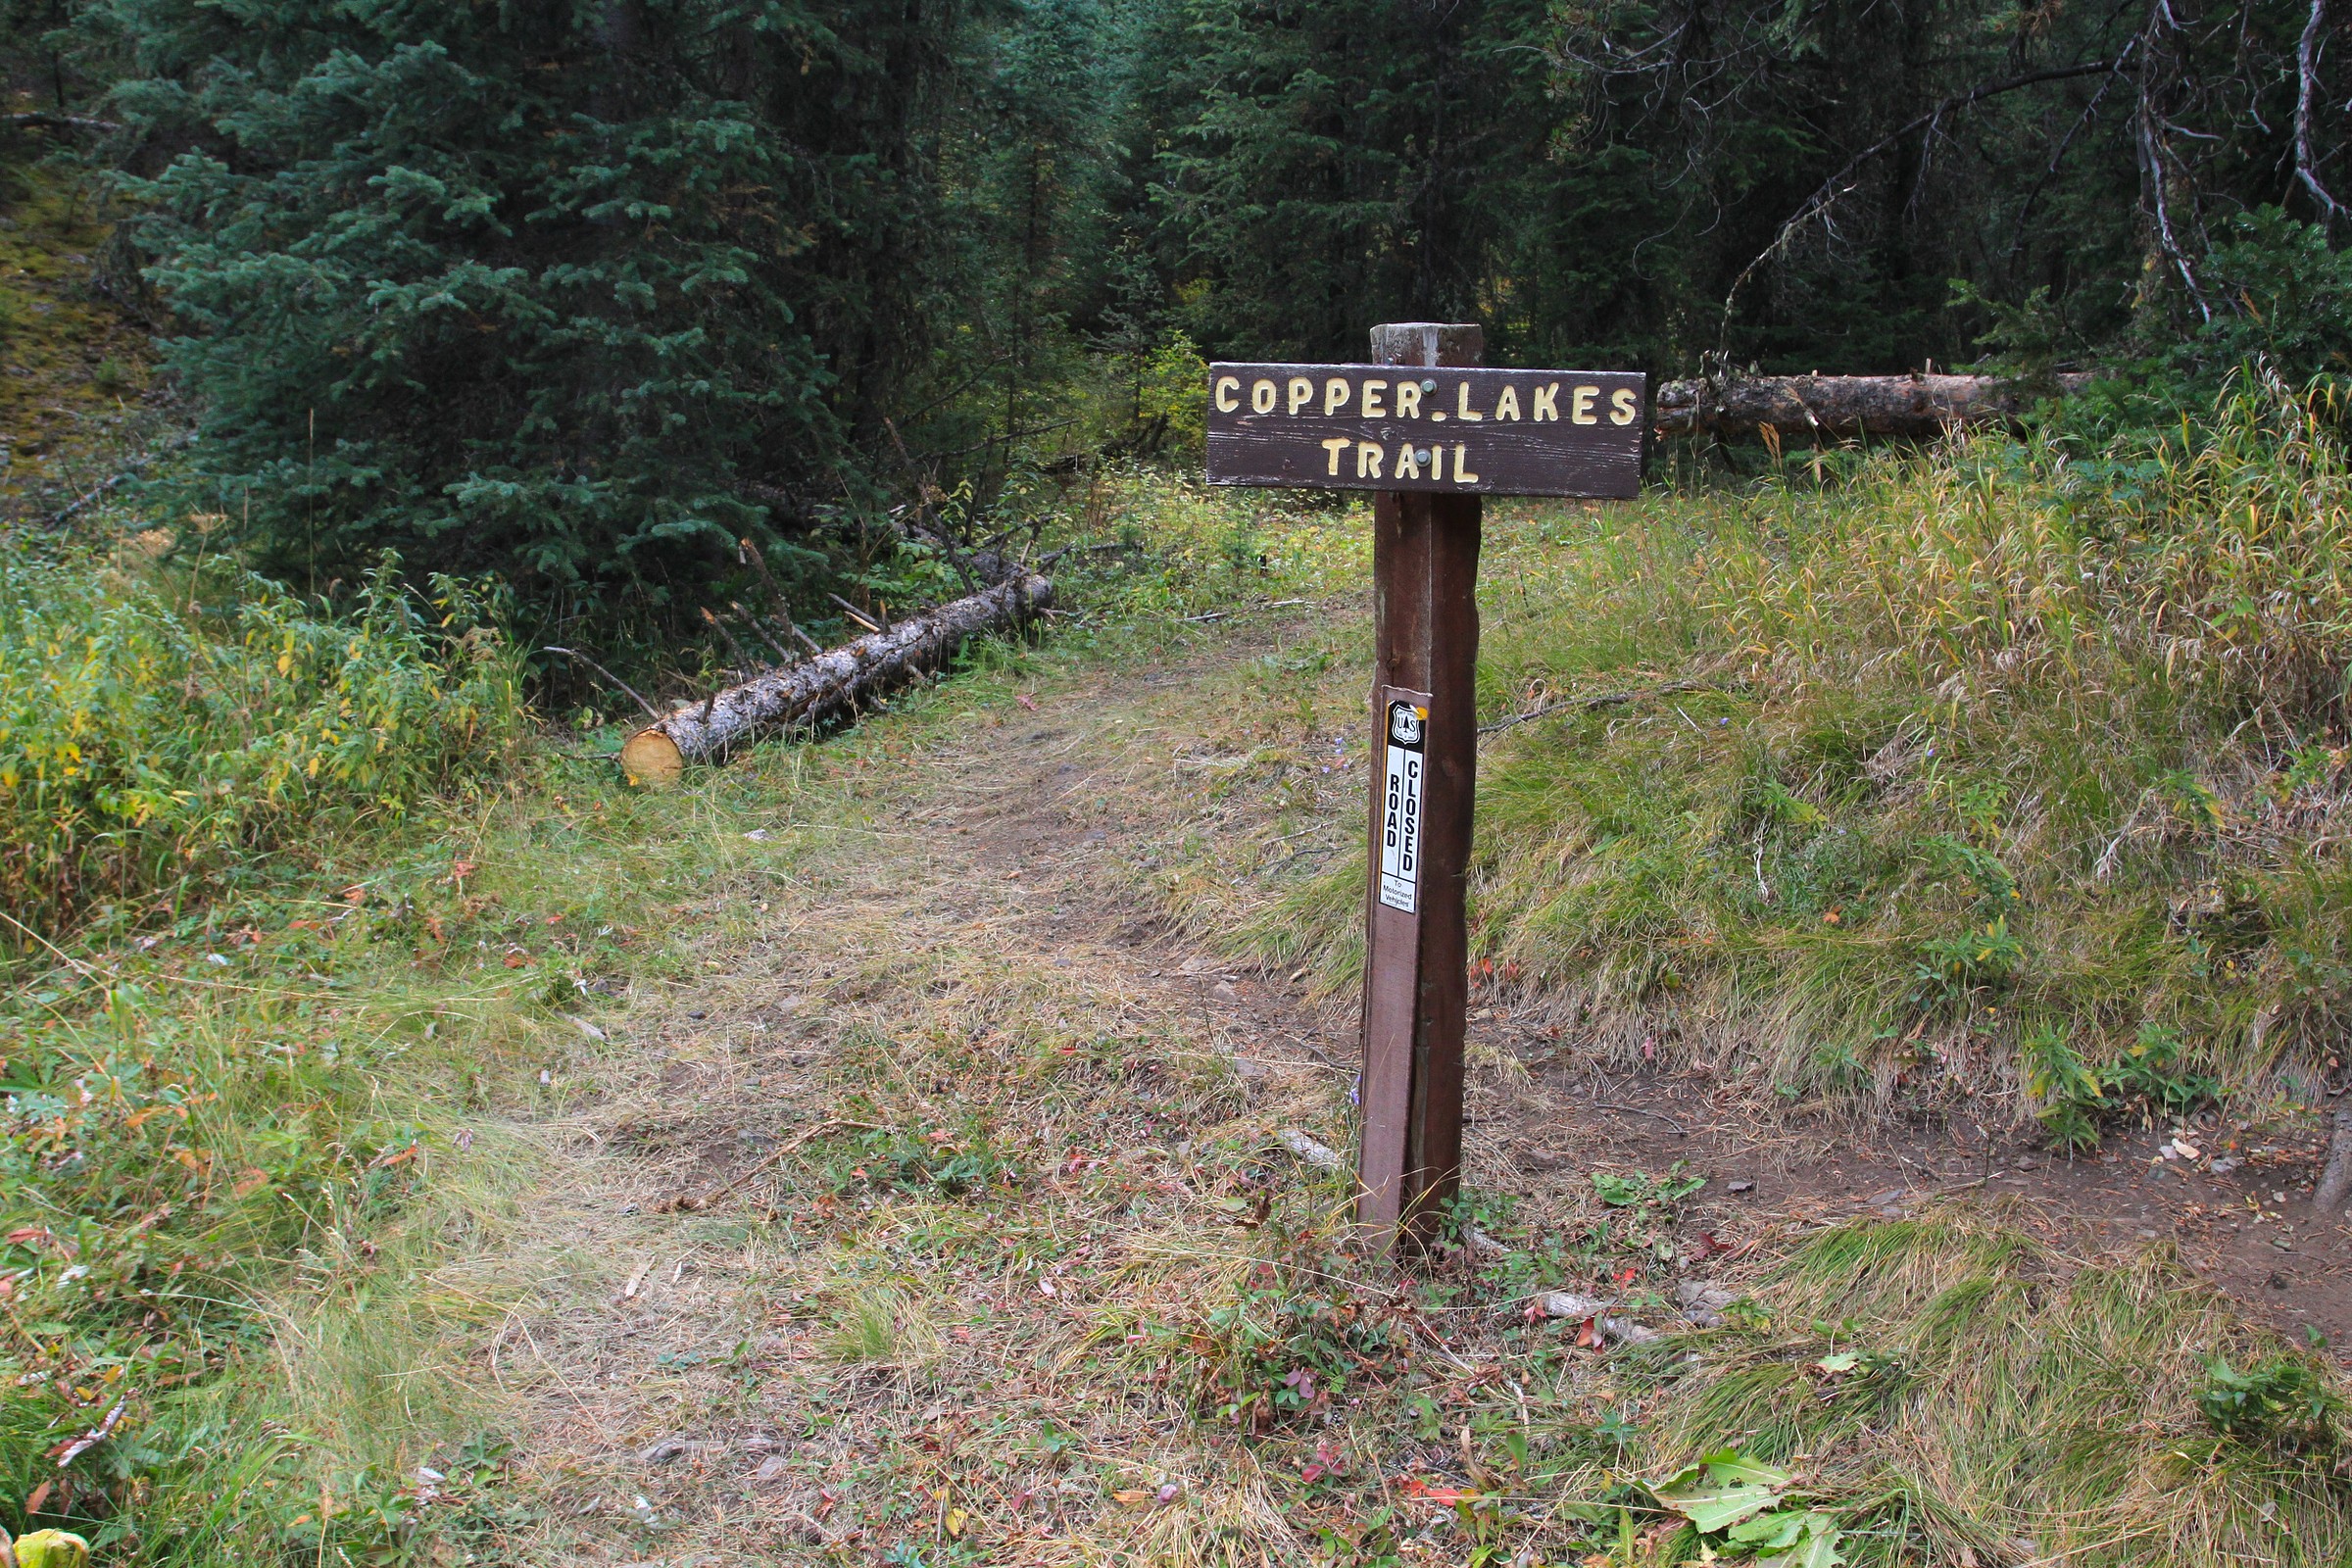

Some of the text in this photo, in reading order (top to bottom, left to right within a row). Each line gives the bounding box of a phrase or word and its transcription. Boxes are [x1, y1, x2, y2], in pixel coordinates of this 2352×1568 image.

[1457, 381, 1637, 426] LAKES
[1321, 437, 1479, 484] TRAIL
[1387, 773, 1399, 848] ROAD
[1402, 760, 1418, 871] CLOSED
[1383, 885, 1412, 900] Motorized
[1395, 879, 1402, 888] To
